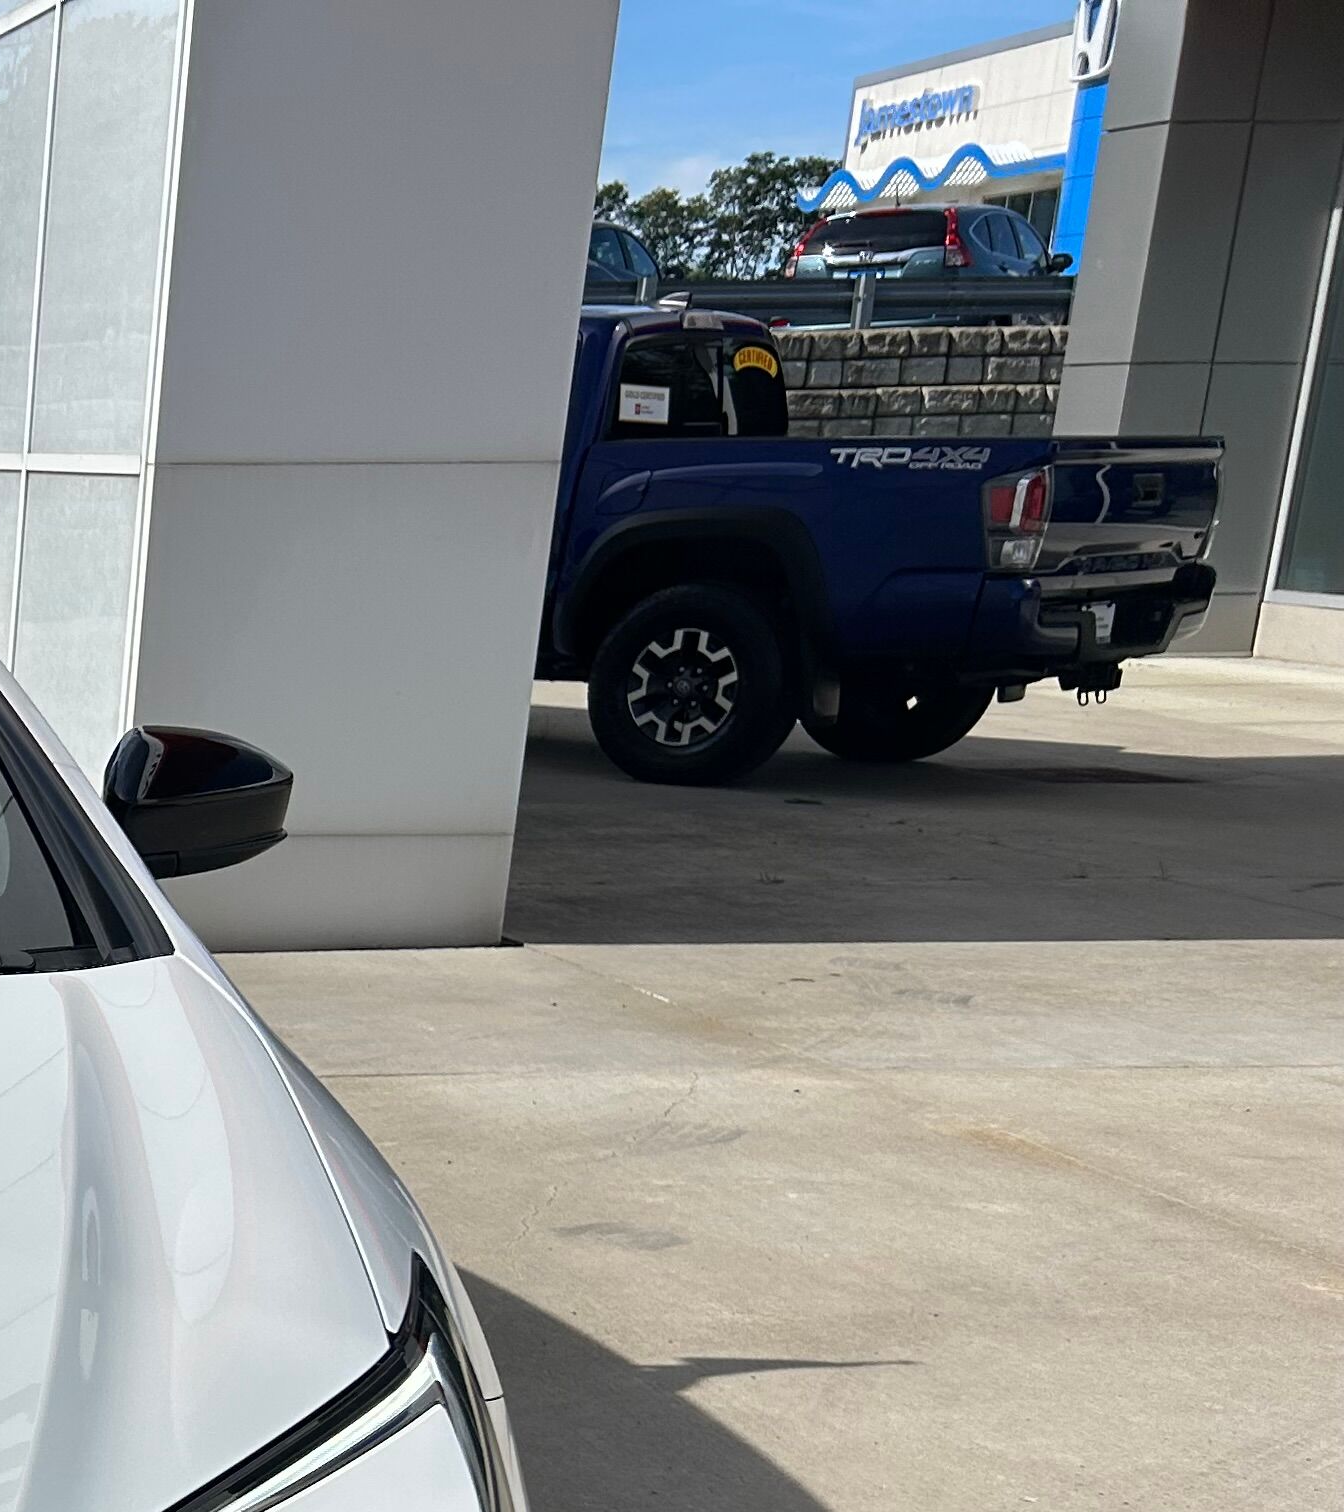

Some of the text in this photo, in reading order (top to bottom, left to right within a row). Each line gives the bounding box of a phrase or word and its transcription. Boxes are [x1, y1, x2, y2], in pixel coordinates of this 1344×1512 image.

[854, 85, 977, 147] Jamestown
[738, 349, 773, 371] CERTIFIED
[830, 448, 912, 468] TRD
[940, 462, 982, 470] ROAD
